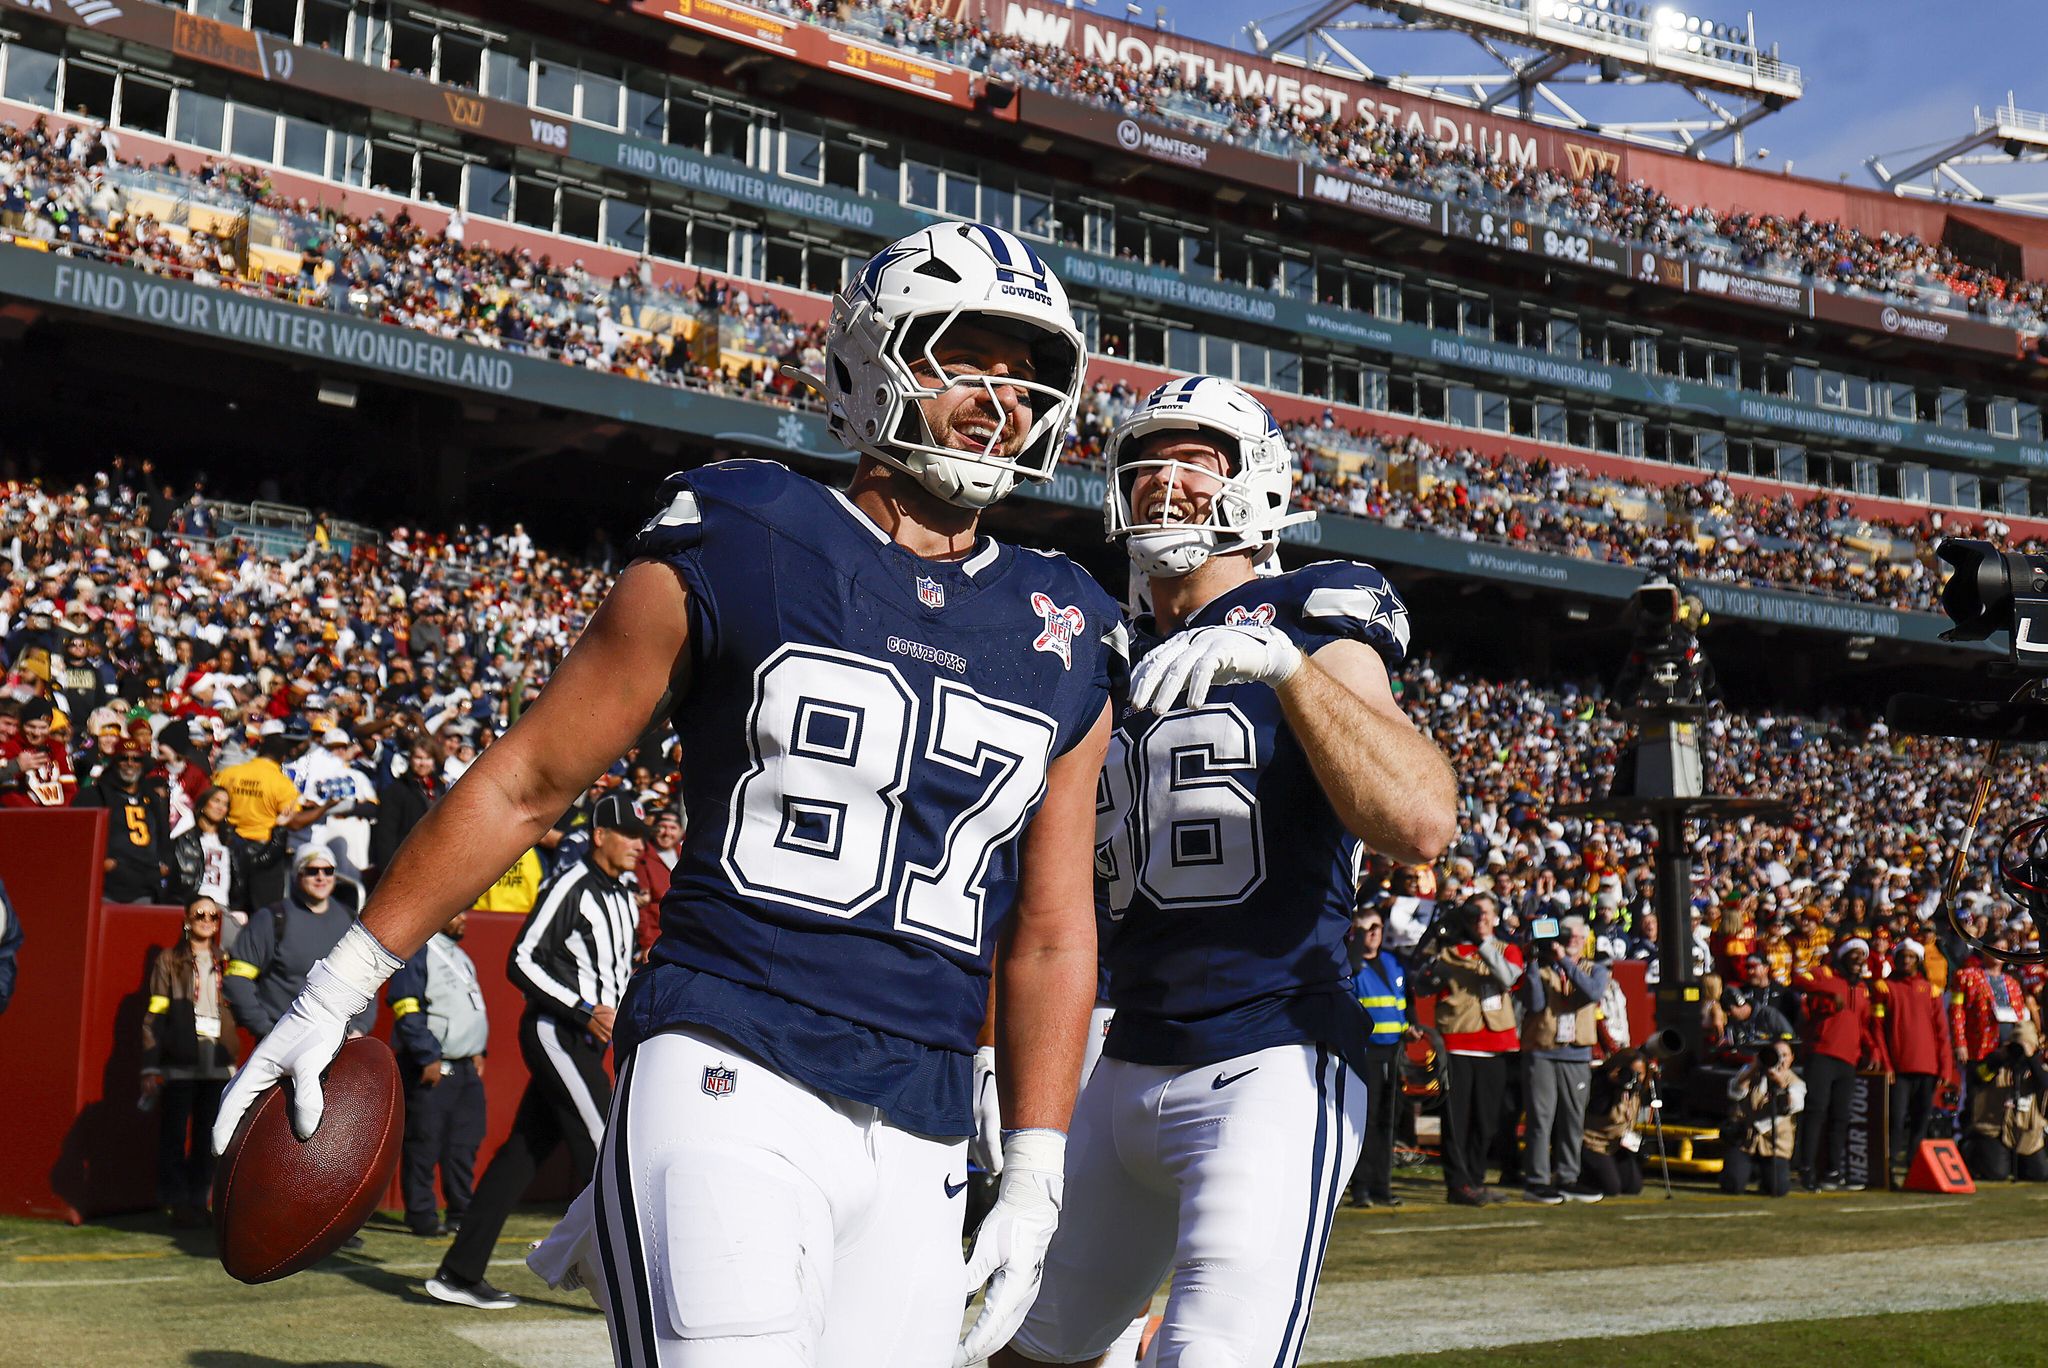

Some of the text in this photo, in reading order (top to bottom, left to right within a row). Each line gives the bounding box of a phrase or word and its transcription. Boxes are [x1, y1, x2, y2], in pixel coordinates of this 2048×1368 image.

[1084, 23, 1349, 124] NORTHWEST
[1356, 98, 1538, 166] STADIUM
[530, 118, 568, 149] YDS
[1142, 131, 1208, 160] MANTECH
[618, 143, 873, 227] FIND YOUR WINTER WONDERLAND
[1351, 184, 1433, 214] NORTHWEST
[1480, 213, 1494, 236] 6
[1543, 230, 1590, 264] 9:42
[1001, 284, 1052, 307] COWBOYS
[1065, 256, 1276, 320] FIND YOUR WINTER WONDERLAND
[1730, 276, 1801, 300] NORTHWEST
[54, 265, 513, 390] FIND YOUR WINTER WONDERLAND
[1305, 313, 1392, 343] WVtourism.com
[1901, 316, 1948, 334] MANTECH
[1431, 338, 1612, 390] FIND YOUR WINTER WONDERLAND
[1740, 400, 1902, 442] FIND YOUR WINTER WONDERLAND
[1467, 551, 1568, 581] WVtourism.com
[921, 588, 941, 604] NFL
[1725, 590, 1760, 616] YOUR
[1761, 598, 1813, 624] WINTER
[1814, 604, 1900, 636] WONDERLAND
[1050, 622, 1068, 641] NFL
[887, 635, 966, 674] COWBOYS
[720, 641, 1059, 956] 87
[125, 804, 151, 847] 5
[707, 1077, 731, 1092] NFL
[1849, 1078, 1868, 1182] HEAR YOU!
